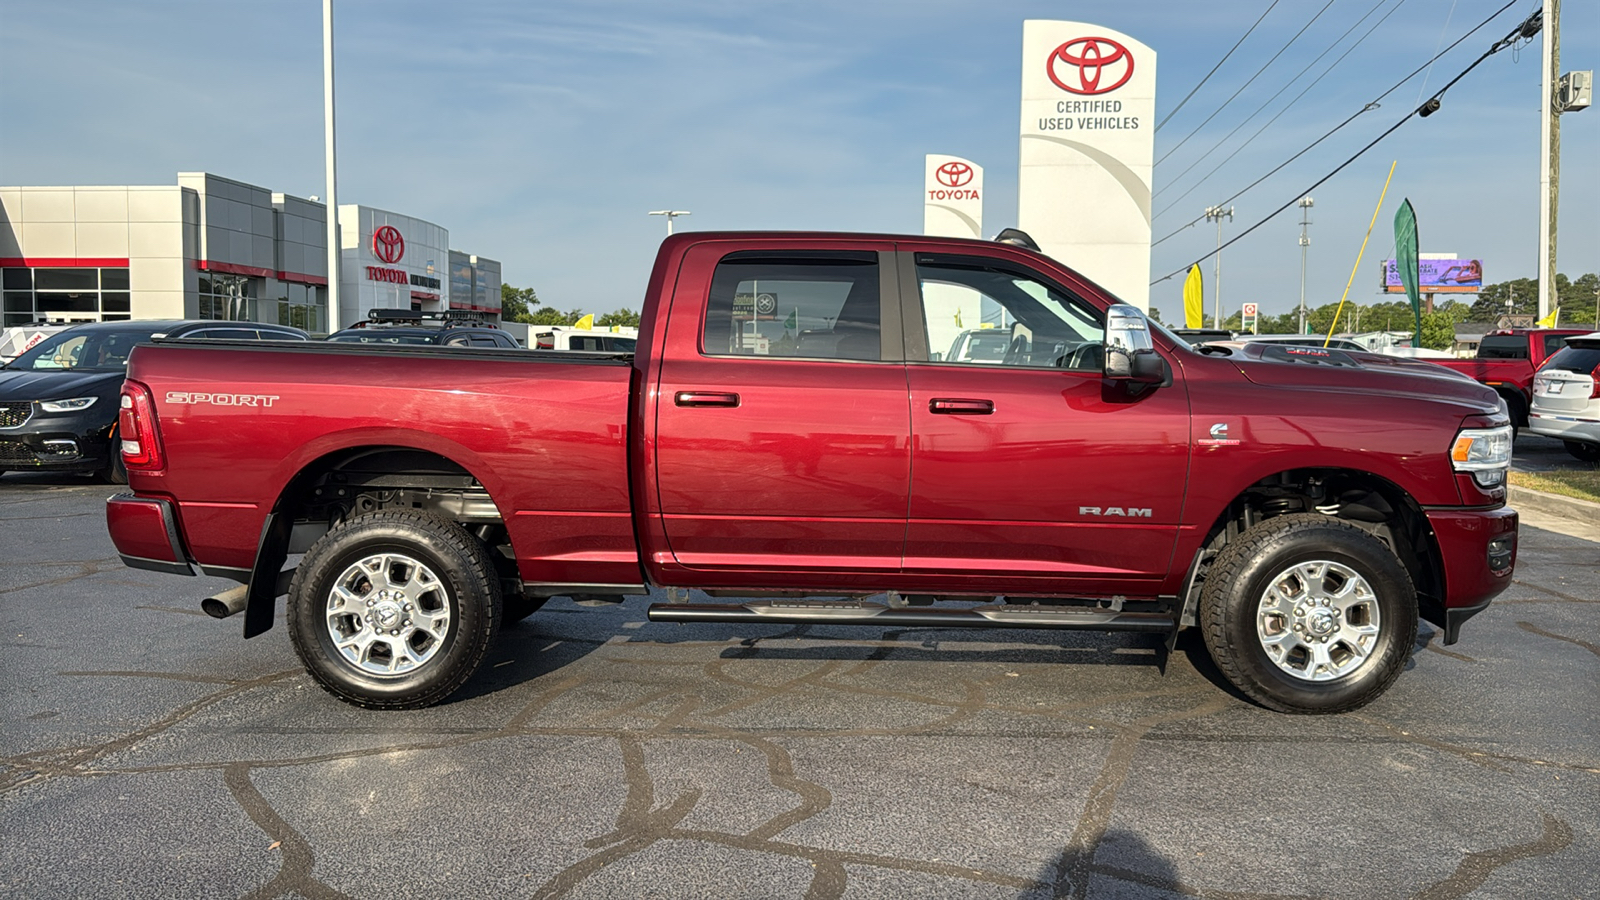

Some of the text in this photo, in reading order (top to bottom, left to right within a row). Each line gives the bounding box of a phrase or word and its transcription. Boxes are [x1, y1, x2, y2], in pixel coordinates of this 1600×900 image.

[1056, 100, 1122, 113] CERTIFIED
[1039, 117, 1139, 130] USED VEHICLES
[929, 190, 980, 200] TOYOTA
[367, 266, 408, 284] TOYOTA
[165, 391, 280, 407] SPORT
[1079, 506, 1152, 517] RAM
